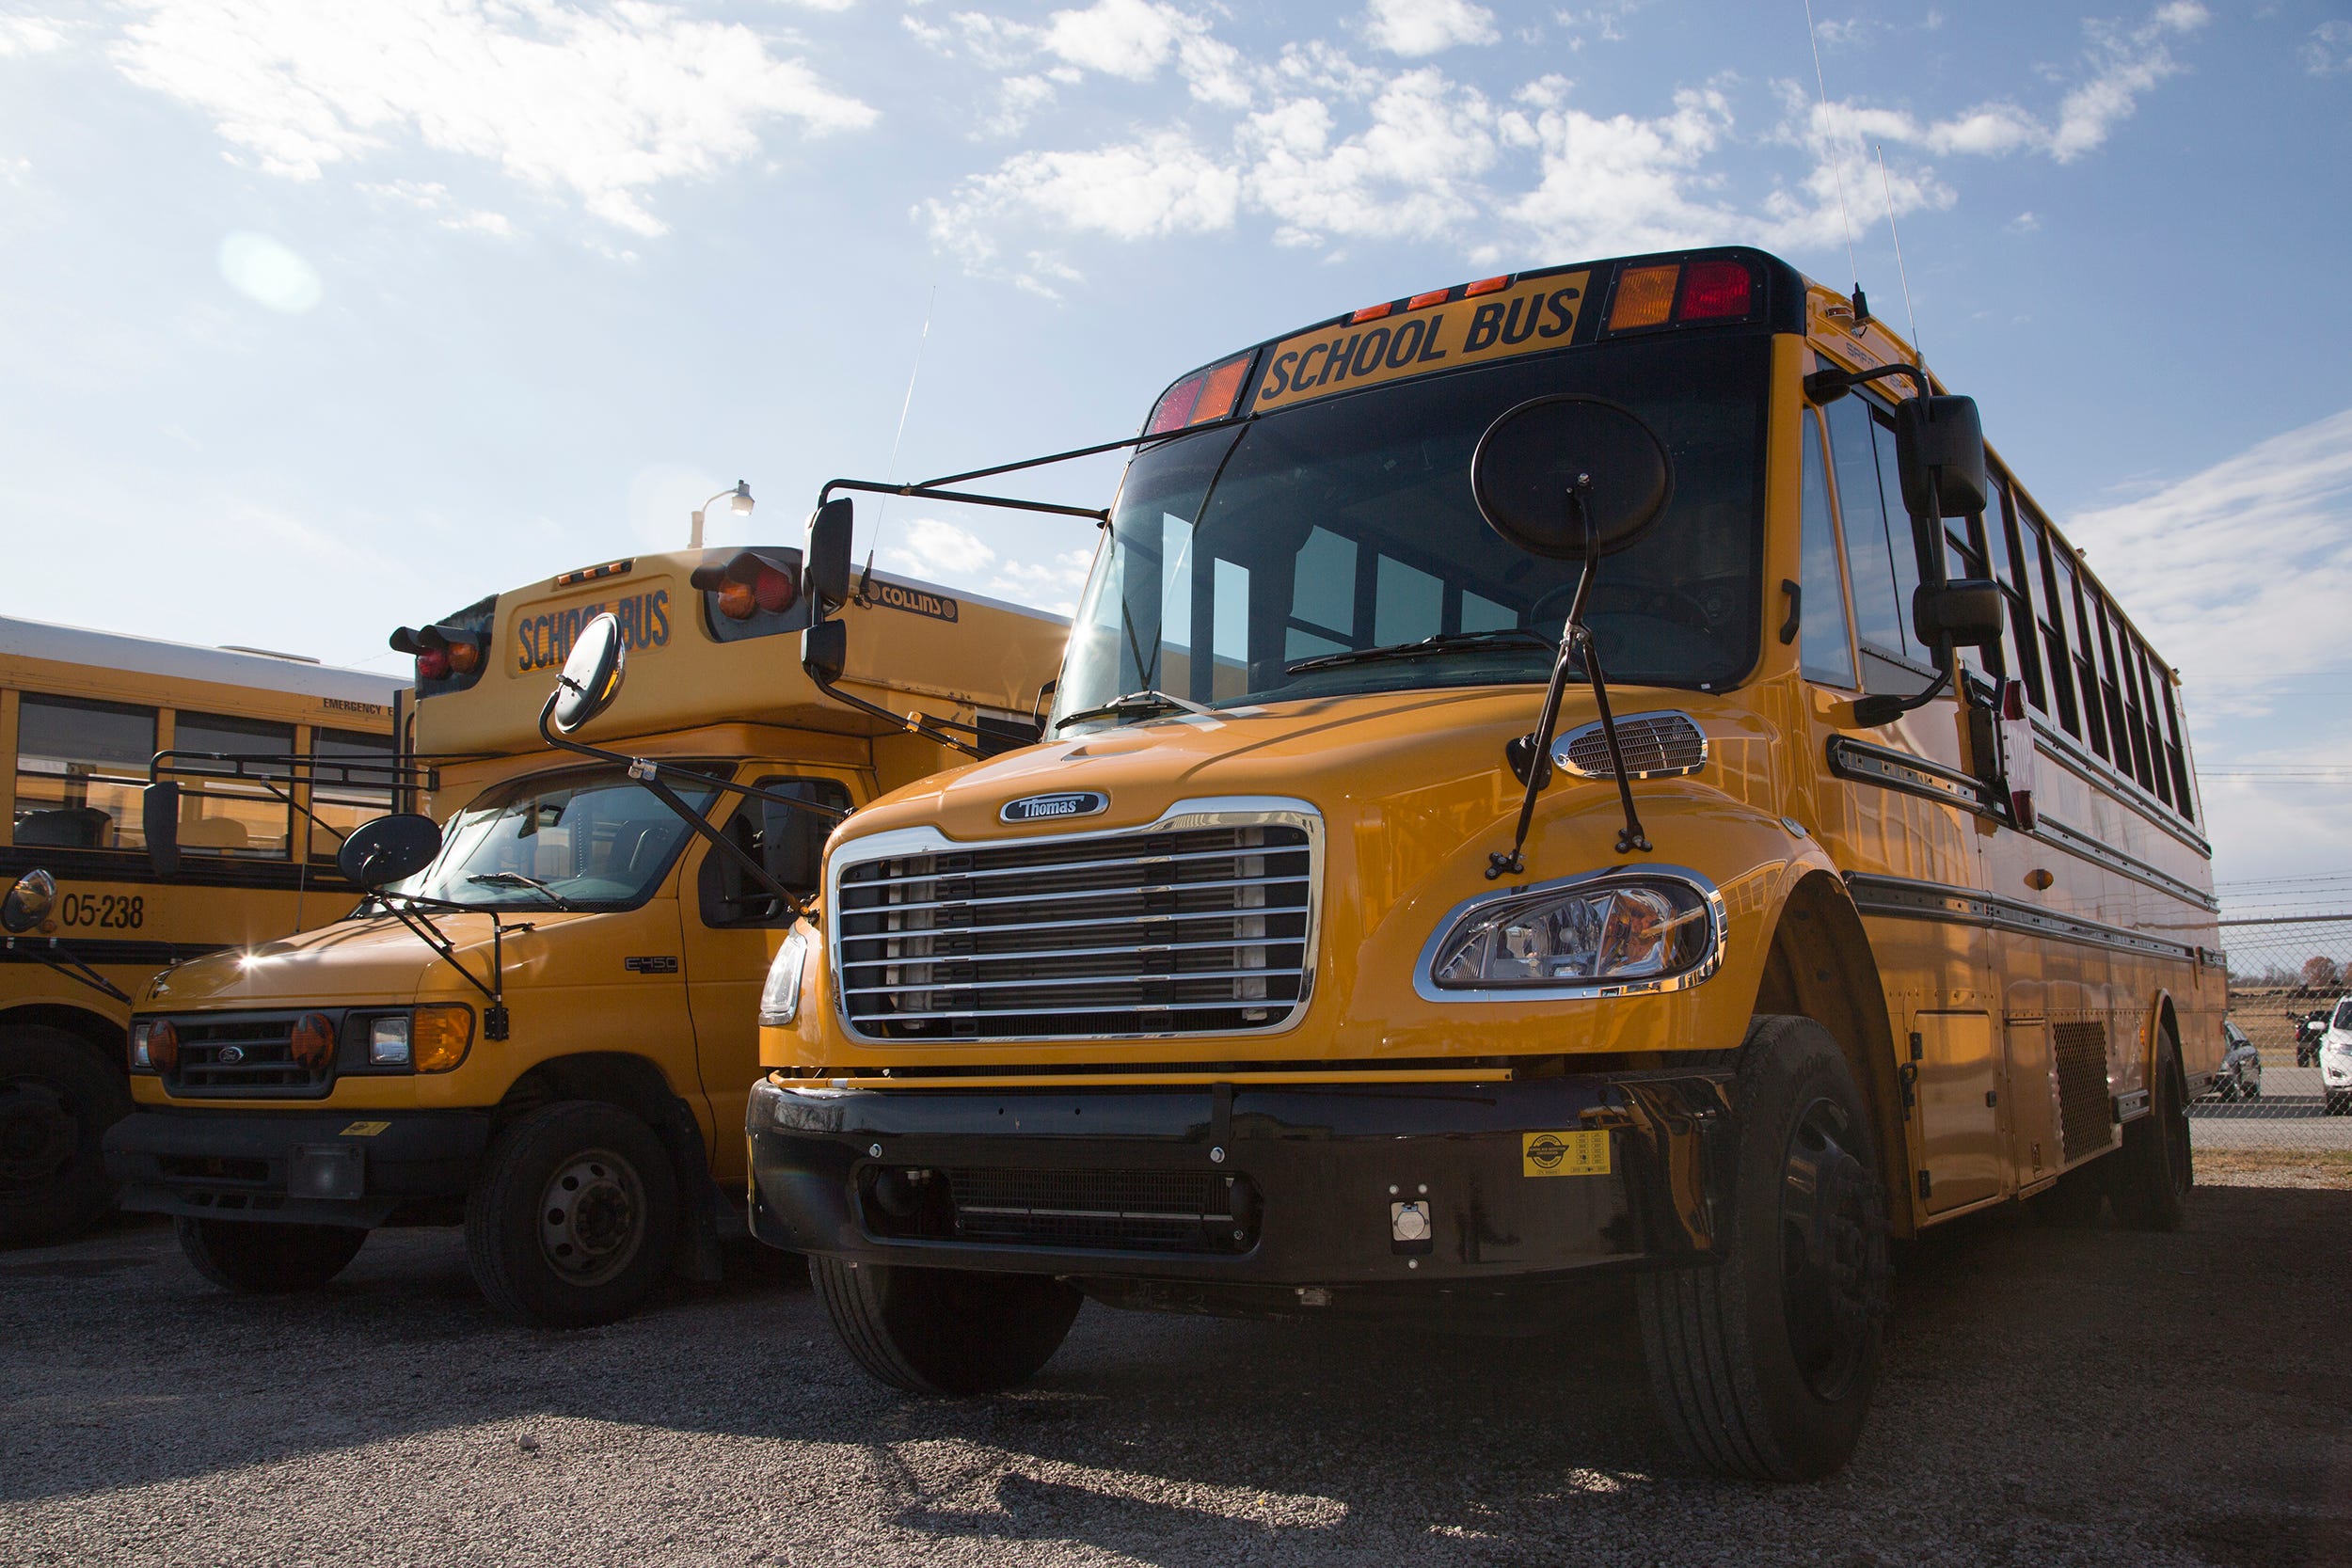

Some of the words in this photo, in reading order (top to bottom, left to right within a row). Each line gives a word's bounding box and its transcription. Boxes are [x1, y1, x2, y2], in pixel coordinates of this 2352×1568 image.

[1262, 314, 1448, 401] SCHOOL
[1462, 287, 1580, 354] BUS
[882, 586, 942, 615] COLLINS
[519, 603, 606, 672] SCHO
[619, 590, 669, 651] BUS
[323, 697, 382, 716] EMERGENCY
[2007, 723, 2031, 785] STOP
[1019, 796, 1085, 817] Thomas
[62, 893, 144, 929] 05-238
